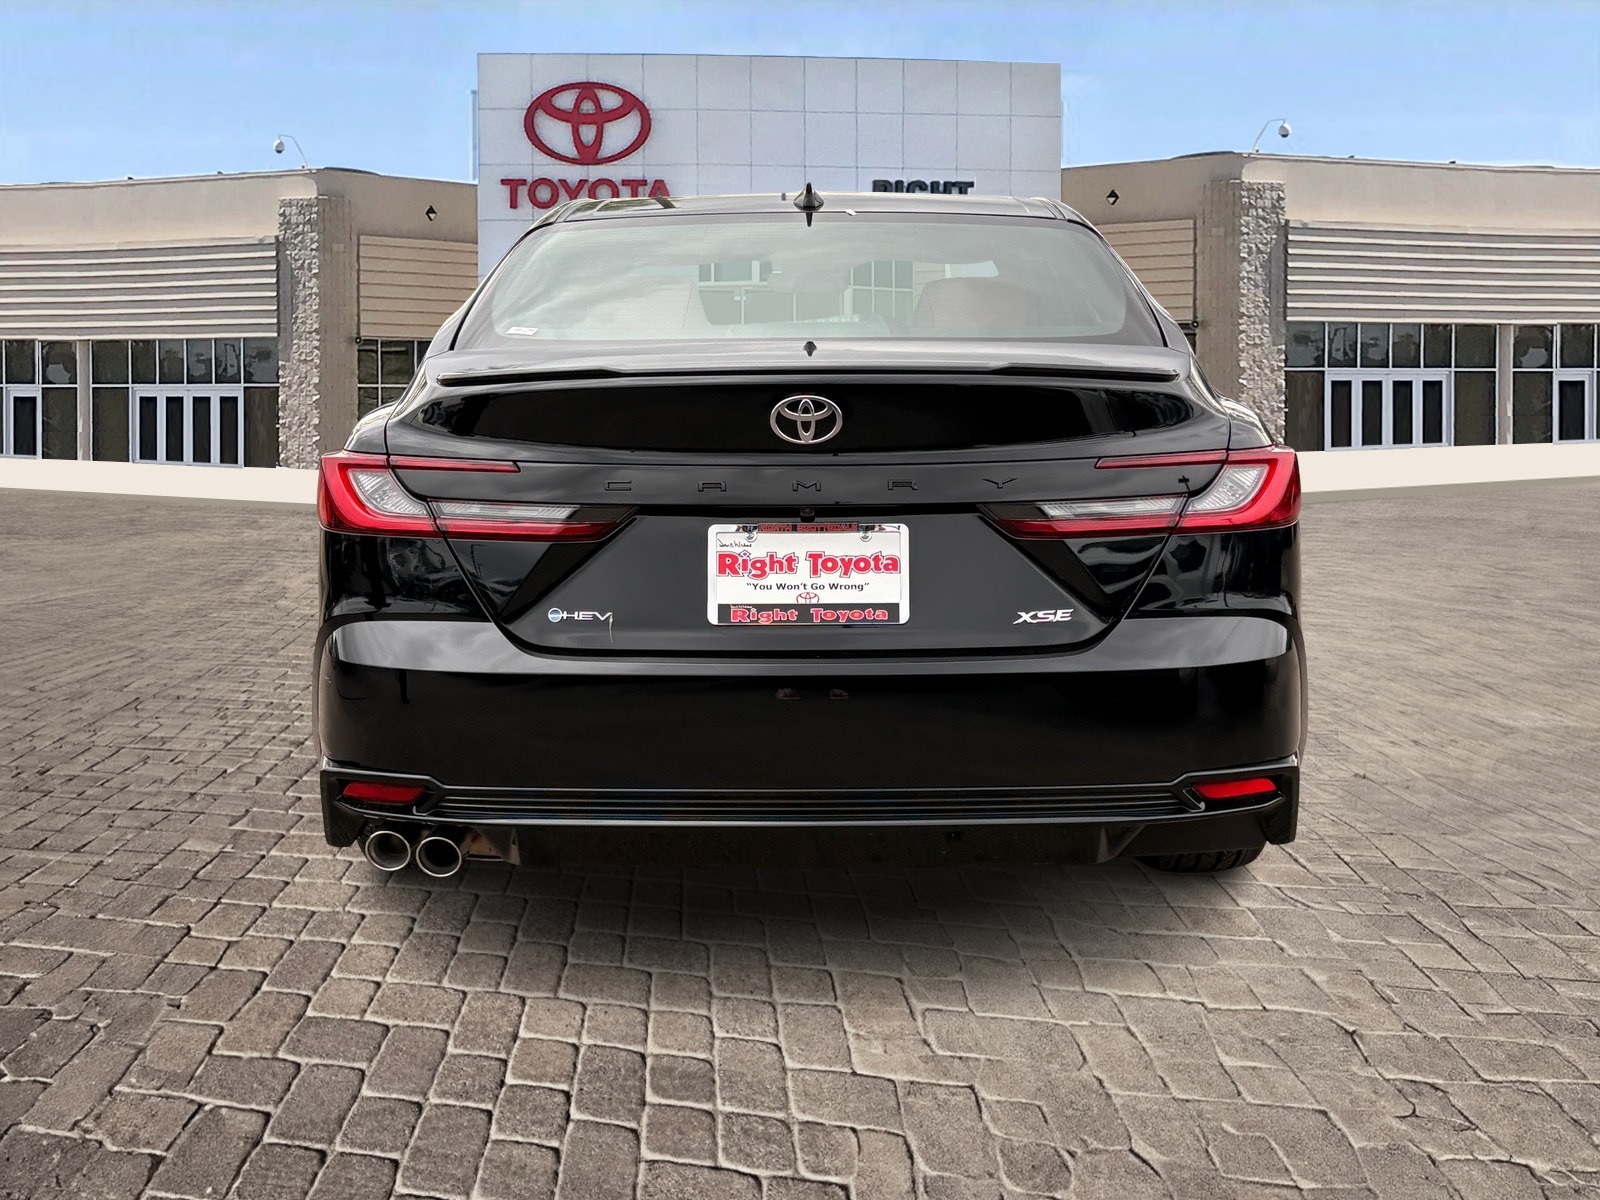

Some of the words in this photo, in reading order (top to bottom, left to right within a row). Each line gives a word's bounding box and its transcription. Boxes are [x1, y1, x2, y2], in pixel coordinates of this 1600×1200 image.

[500, 177, 671, 210] TOYOTA
[716, 551, 799, 580] Right
[805, 551, 901, 578] Toyota
[810, 582, 825, 591] Go
[730, 608, 798, 624] Right
[811, 607, 888, 622] Toyota
[1012, 608, 1075, 625] XSE
